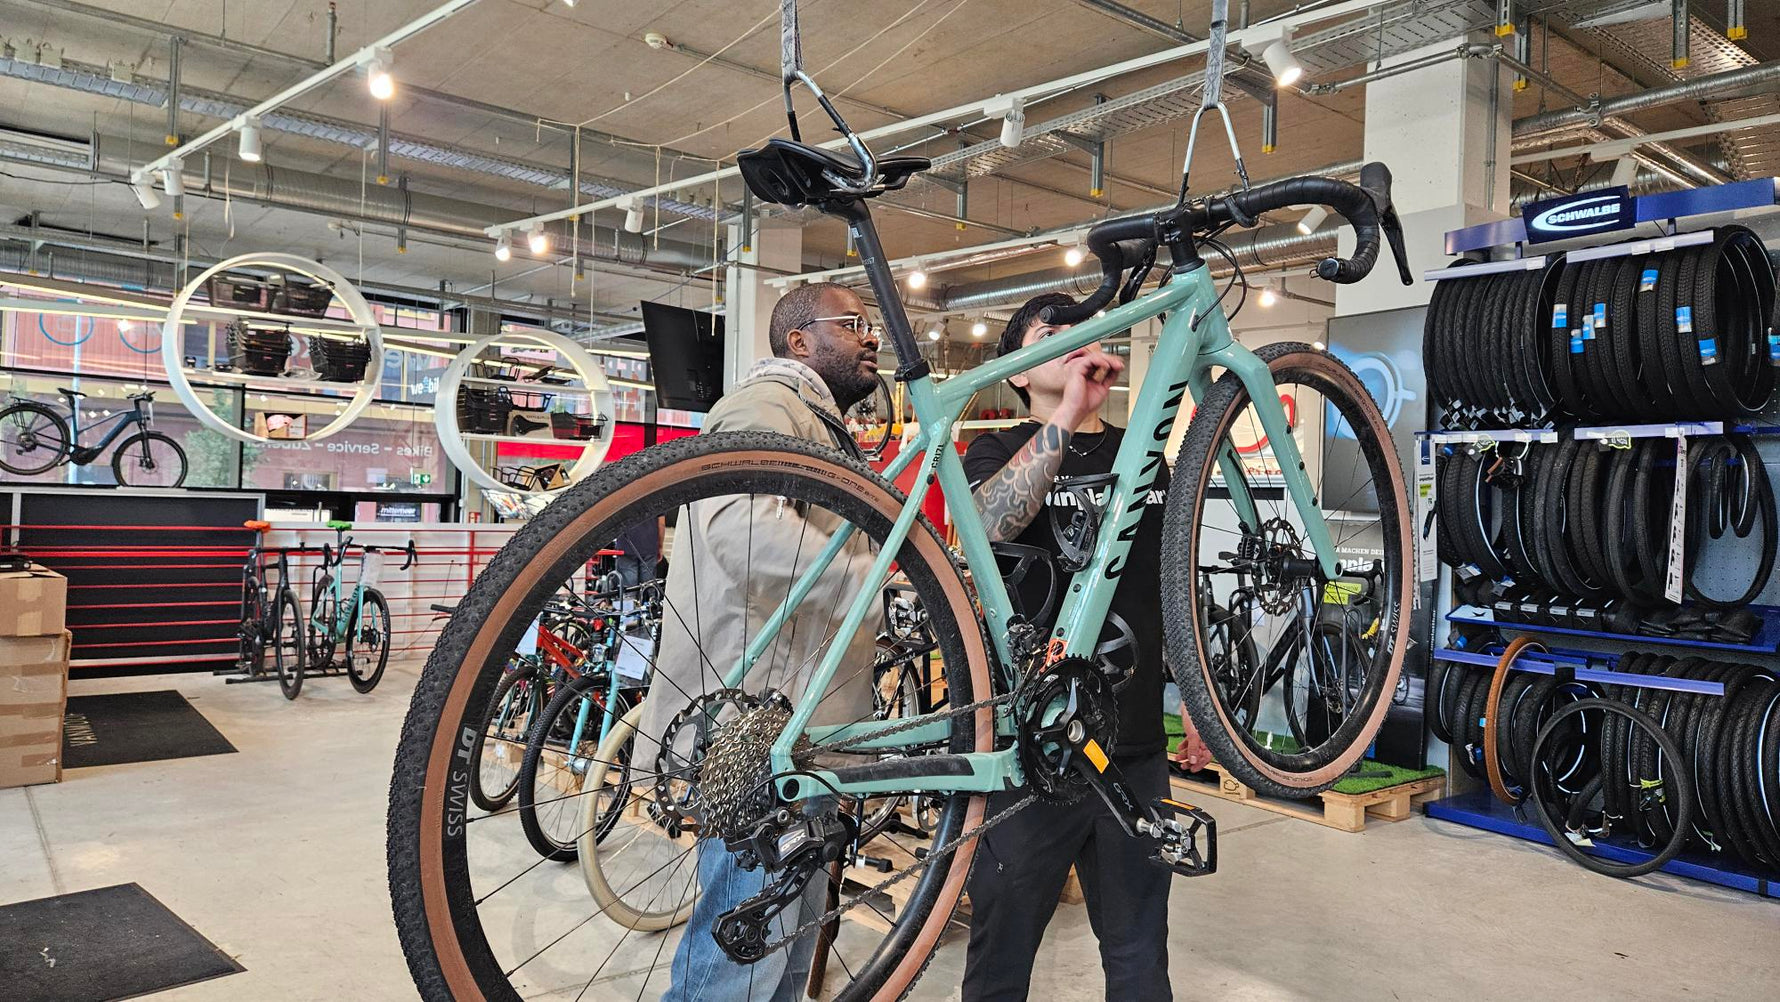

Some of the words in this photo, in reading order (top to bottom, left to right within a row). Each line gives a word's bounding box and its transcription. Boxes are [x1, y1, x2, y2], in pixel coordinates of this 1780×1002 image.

[1547, 203, 1621, 225] SCHWALBE
[1104, 380, 1190, 580] CANYON
[1341, 546, 1370, 556] MACHEN
[1390, 602, 1401, 633] SWISS
[457, 726, 478, 765] DT
[447, 770, 469, 837] SWISS
[1112, 782, 1134, 812] GRX
